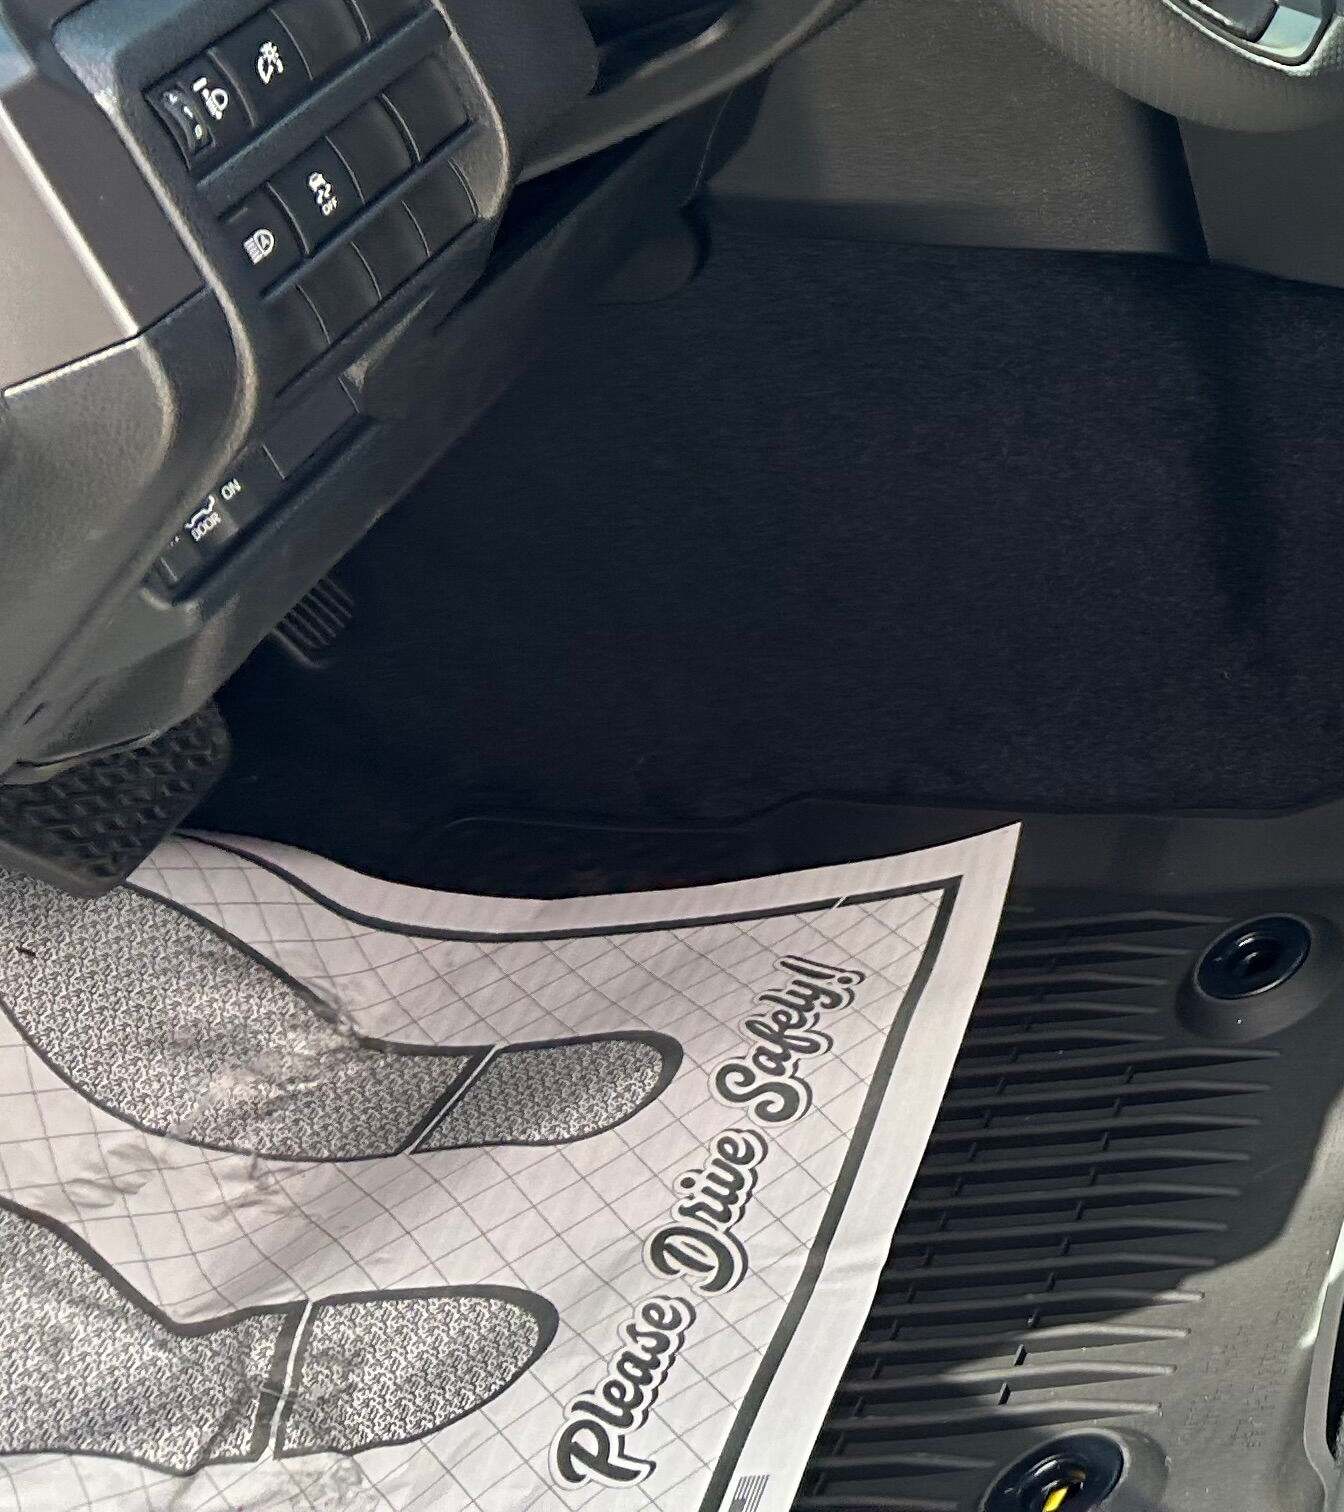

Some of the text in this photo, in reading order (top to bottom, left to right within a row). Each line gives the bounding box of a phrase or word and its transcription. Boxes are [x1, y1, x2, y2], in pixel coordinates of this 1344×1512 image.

[221, 478, 242, 501] ON
[190, 511, 222, 542] DOOR
[552, 955, 866, 1488] Please Drive Safely!
